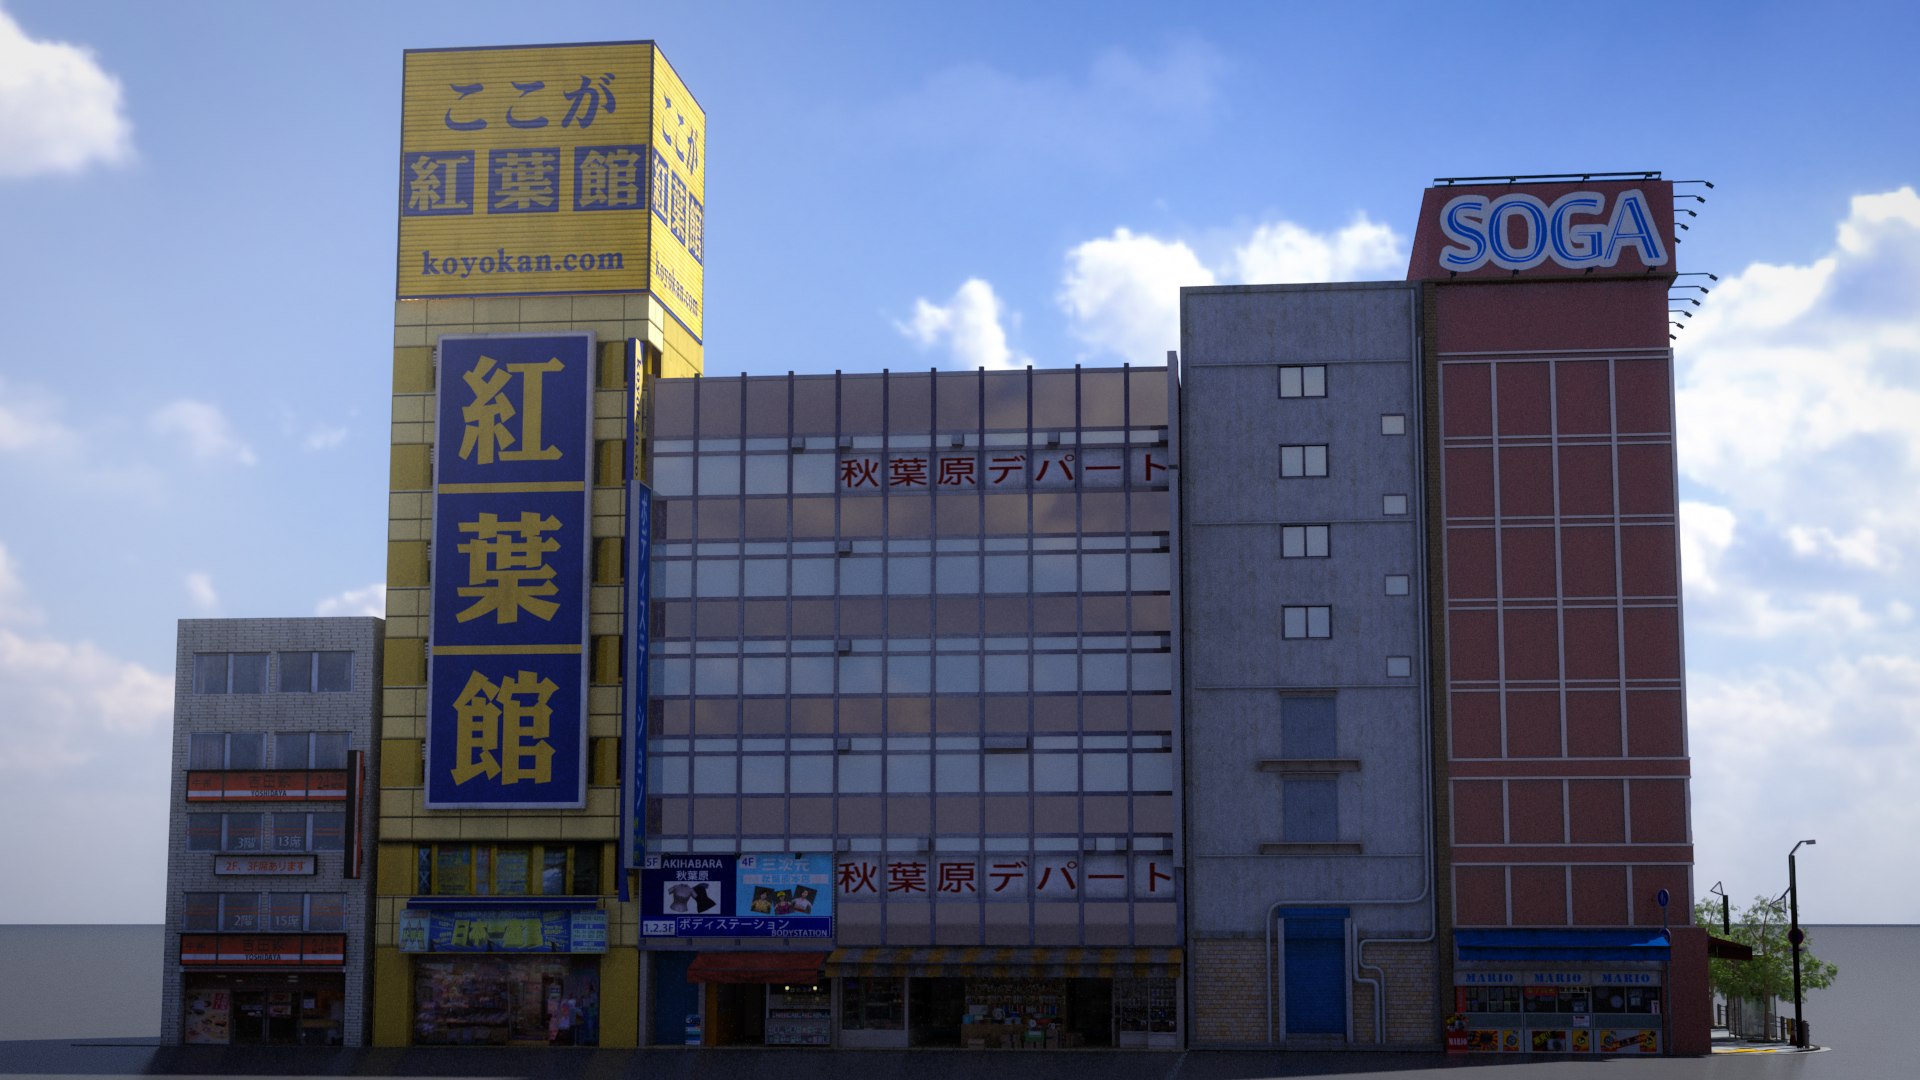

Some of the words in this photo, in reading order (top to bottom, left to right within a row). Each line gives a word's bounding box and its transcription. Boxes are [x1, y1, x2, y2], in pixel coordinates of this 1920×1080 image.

[444, 72, 616, 131] ここが
[662, 91, 698, 176] ここが
[408, 148, 641, 211] 紅葉館
[1439, 189, 1668, 272] SOGA
[421, 248, 625, 279] koyokan.com
[840, 453, 1167, 488] 秋葉原デパート
[450, 355, 567, 786] 紅葉館
[279, 836, 302, 848] 13席
[646, 857, 658, 867] 5F
[662, 859, 723, 869] AKIHABARA
[741, 857, 754, 866] 4F
[762, 858, 810, 872] 三次元
[675, 870, 709, 881] 秋葉原
[838, 860, 1172, 893] 秋葉原デパート
[234, 914, 253, 926] 2階
[275, 914, 300, 926] 15席
[679, 918, 790, 931] ボディステーション
[643, 923, 674, 933] 1.2.3F
[771, 929, 828, 937] BODYSTATION
[1465, 973, 1514, 983] MARIO
[1534, 973, 1582, 983] MARIO
[1602, 973, 1651, 983] MARIO
[1448, 1037, 1468, 1046] MARIO
